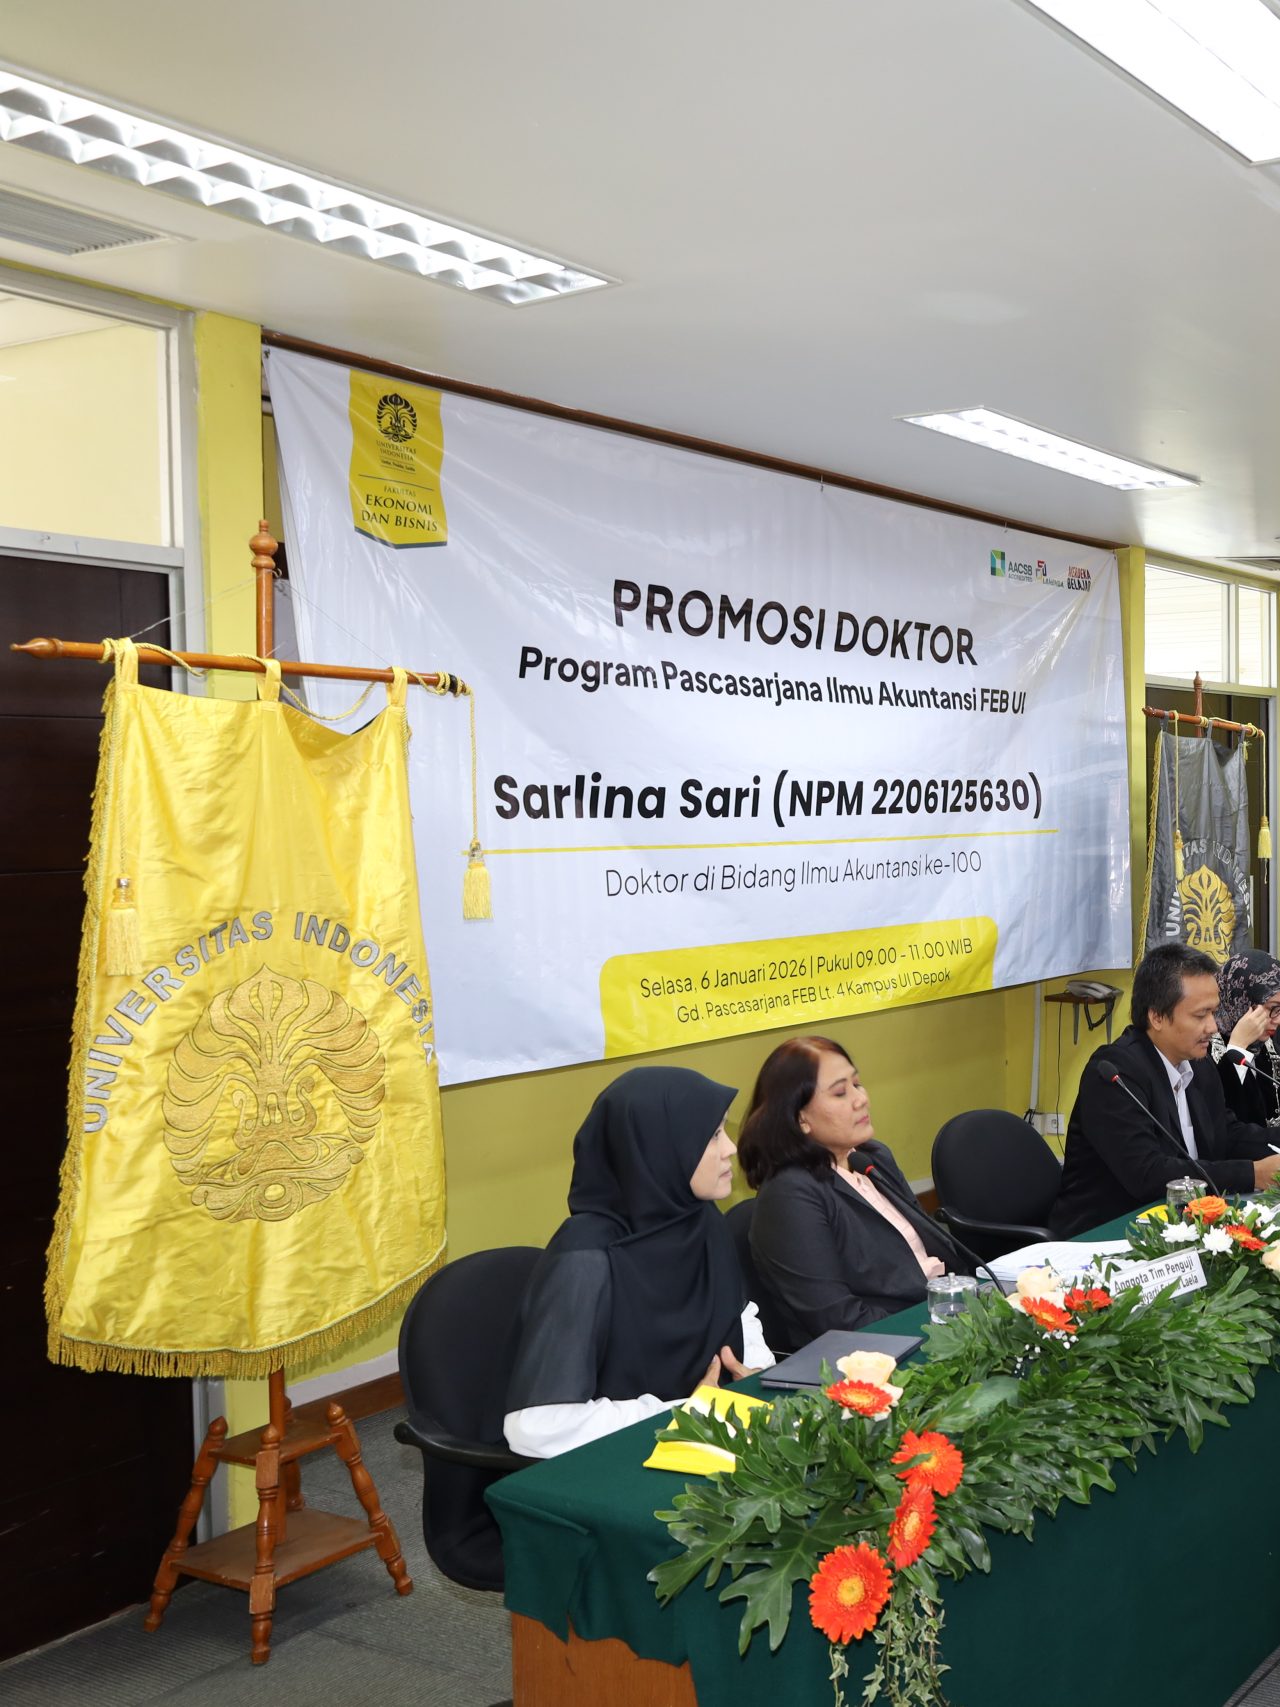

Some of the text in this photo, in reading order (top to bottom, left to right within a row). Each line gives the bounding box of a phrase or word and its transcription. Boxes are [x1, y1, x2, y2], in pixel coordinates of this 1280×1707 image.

[361, 510, 438, 532] DAN BISNIS
[365, 494, 432, 515] EKONOMI
[1008, 561, 1032, 576] AACSB
[613, 579, 978, 665] PROMOSI DOKTOR
[518, 646, 1027, 714] Program Pascasarjana Ilmu Akuntansi FEB UI
[493, 769, 1042, 827] Sarlina Sari (NPM 2206125630)
[605, 850, 982, 896] Doktor di Bidang Ilmu Akuntansi ke-100
[640, 975, 698, 998] Selasa,
[701, 970, 711, 990] 6
[713, 963, 766, 989] Januari
[769, 957, 807, 981] 2026
[817, 952, 853, 974] Pukul
[856, 947, 897, 969] 09.00
[908, 941, 945, 961] 11.00
[945, 937, 973, 956] WIB
[677, 968, 951, 1024] Gd. Pascasarjana FEB Lt. 4 Kampus UI Depok
[84, 911, 273, 1133] UNIVERSITAS
[1114, 1273, 1149, 1293] Anggota
[1148, 1265, 1166, 1280] Tim
[1165, 1256, 1194, 1275] Penguji
[1181, 1274, 1199, 1288] Laela
